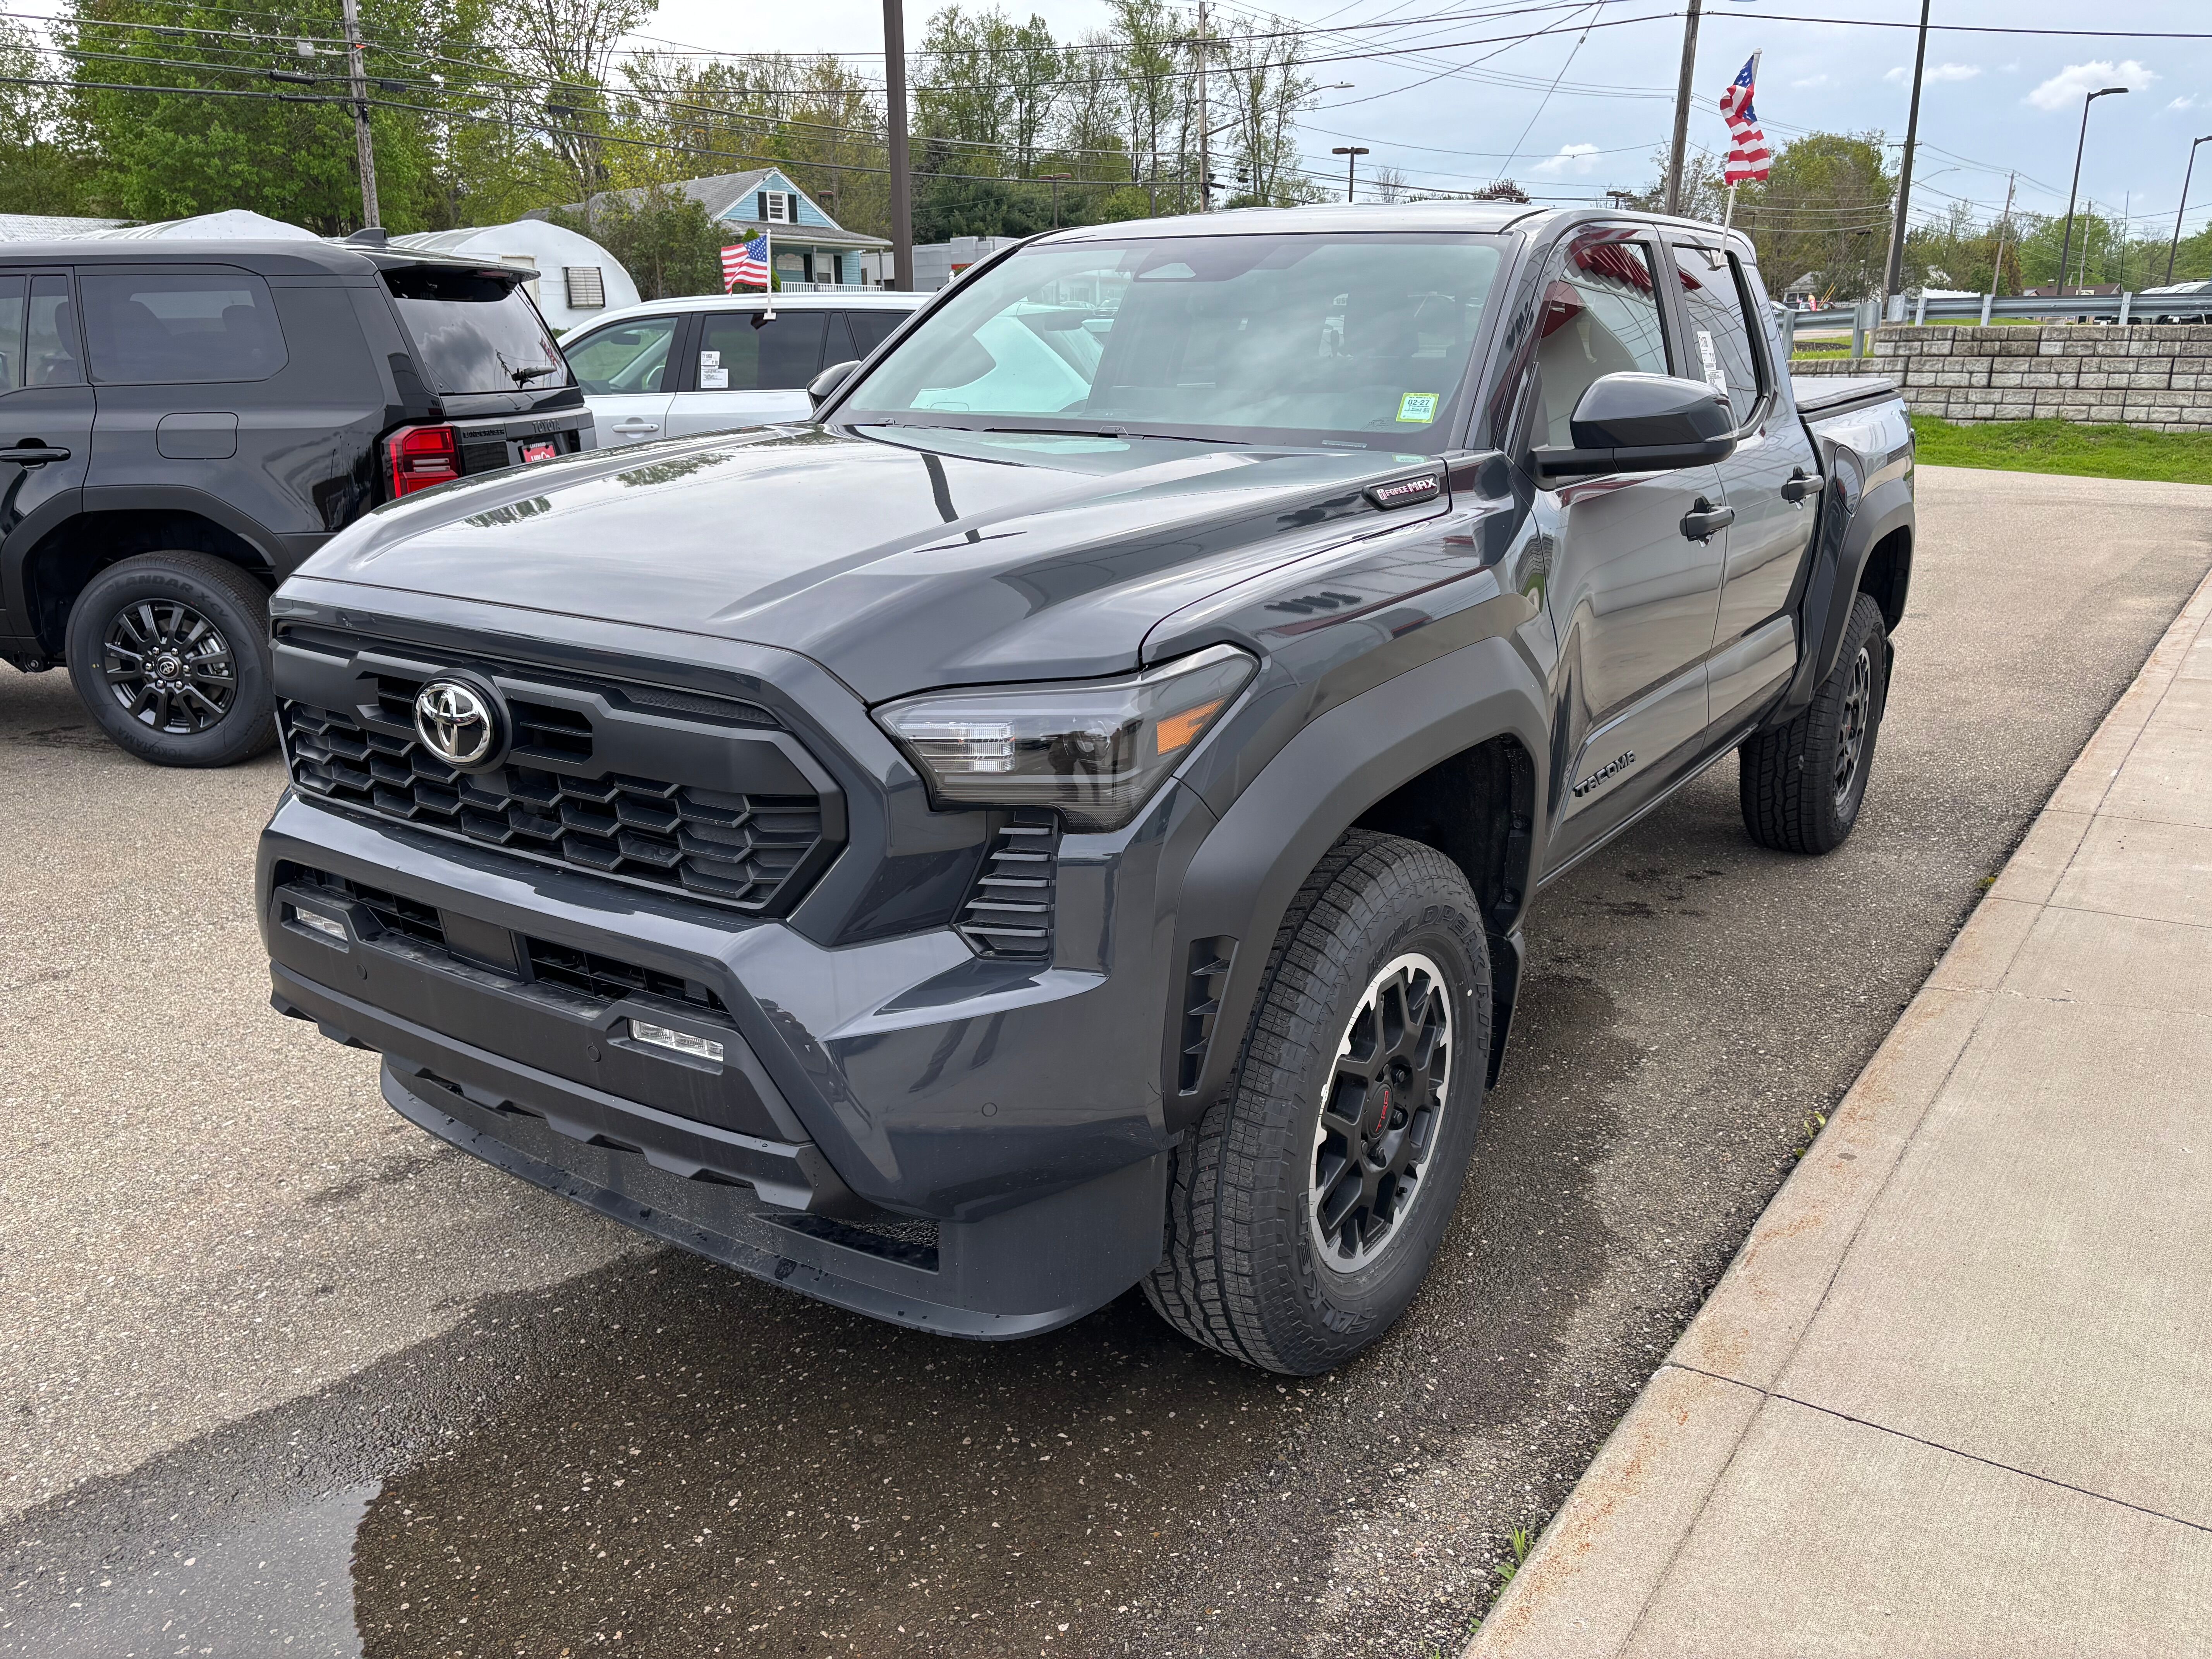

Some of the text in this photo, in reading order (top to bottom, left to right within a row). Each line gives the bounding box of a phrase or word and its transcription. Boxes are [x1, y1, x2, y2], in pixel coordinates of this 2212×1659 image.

[532, 419, 560, 433] TOYOTA
[1407, 478, 1437, 492] MAX
[1572, 750, 1636, 797] TACOMA
[1365, 904, 1486, 987] WILDPEAK
